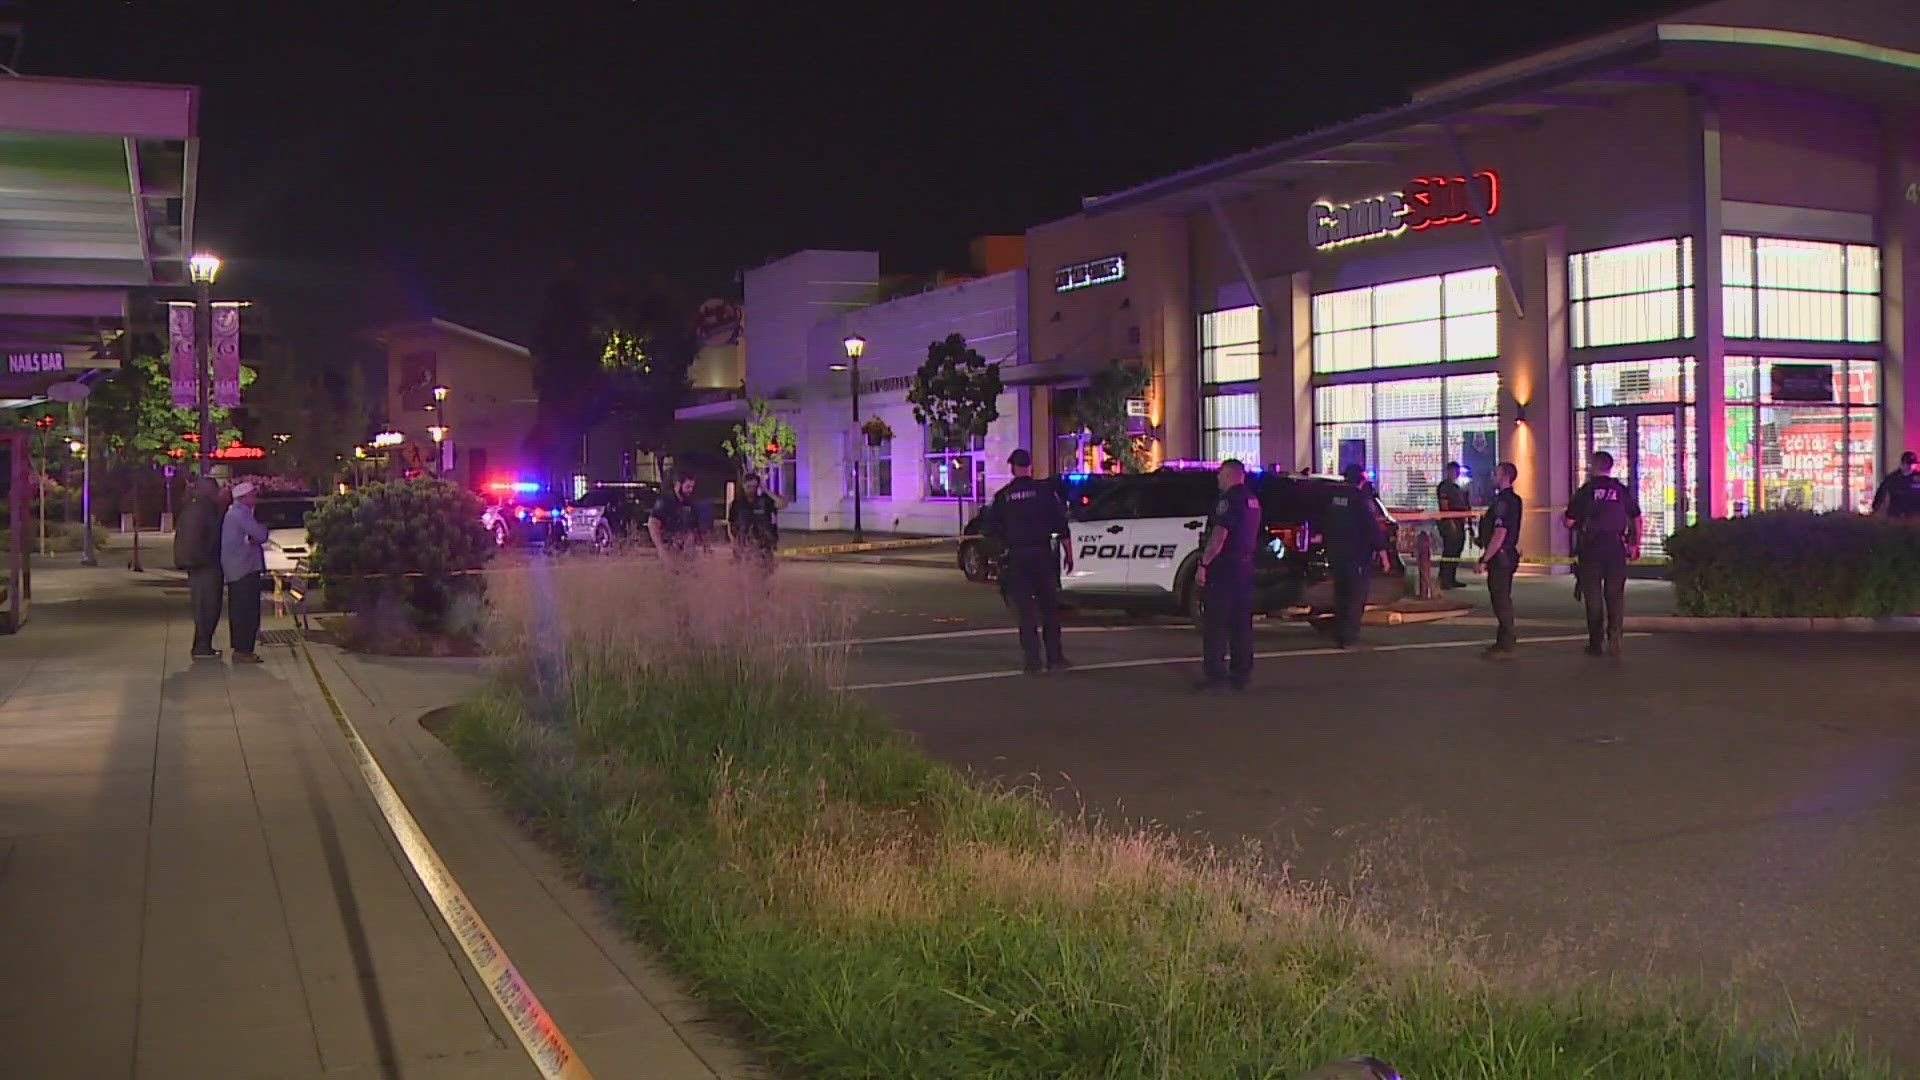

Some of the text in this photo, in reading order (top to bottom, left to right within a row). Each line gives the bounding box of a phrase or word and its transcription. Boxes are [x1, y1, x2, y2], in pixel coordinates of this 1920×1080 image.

[9, 352, 63, 373] NAILS BAR
[1077, 535, 1104, 543] KENT
[1079, 543, 1178, 559] POLICE
